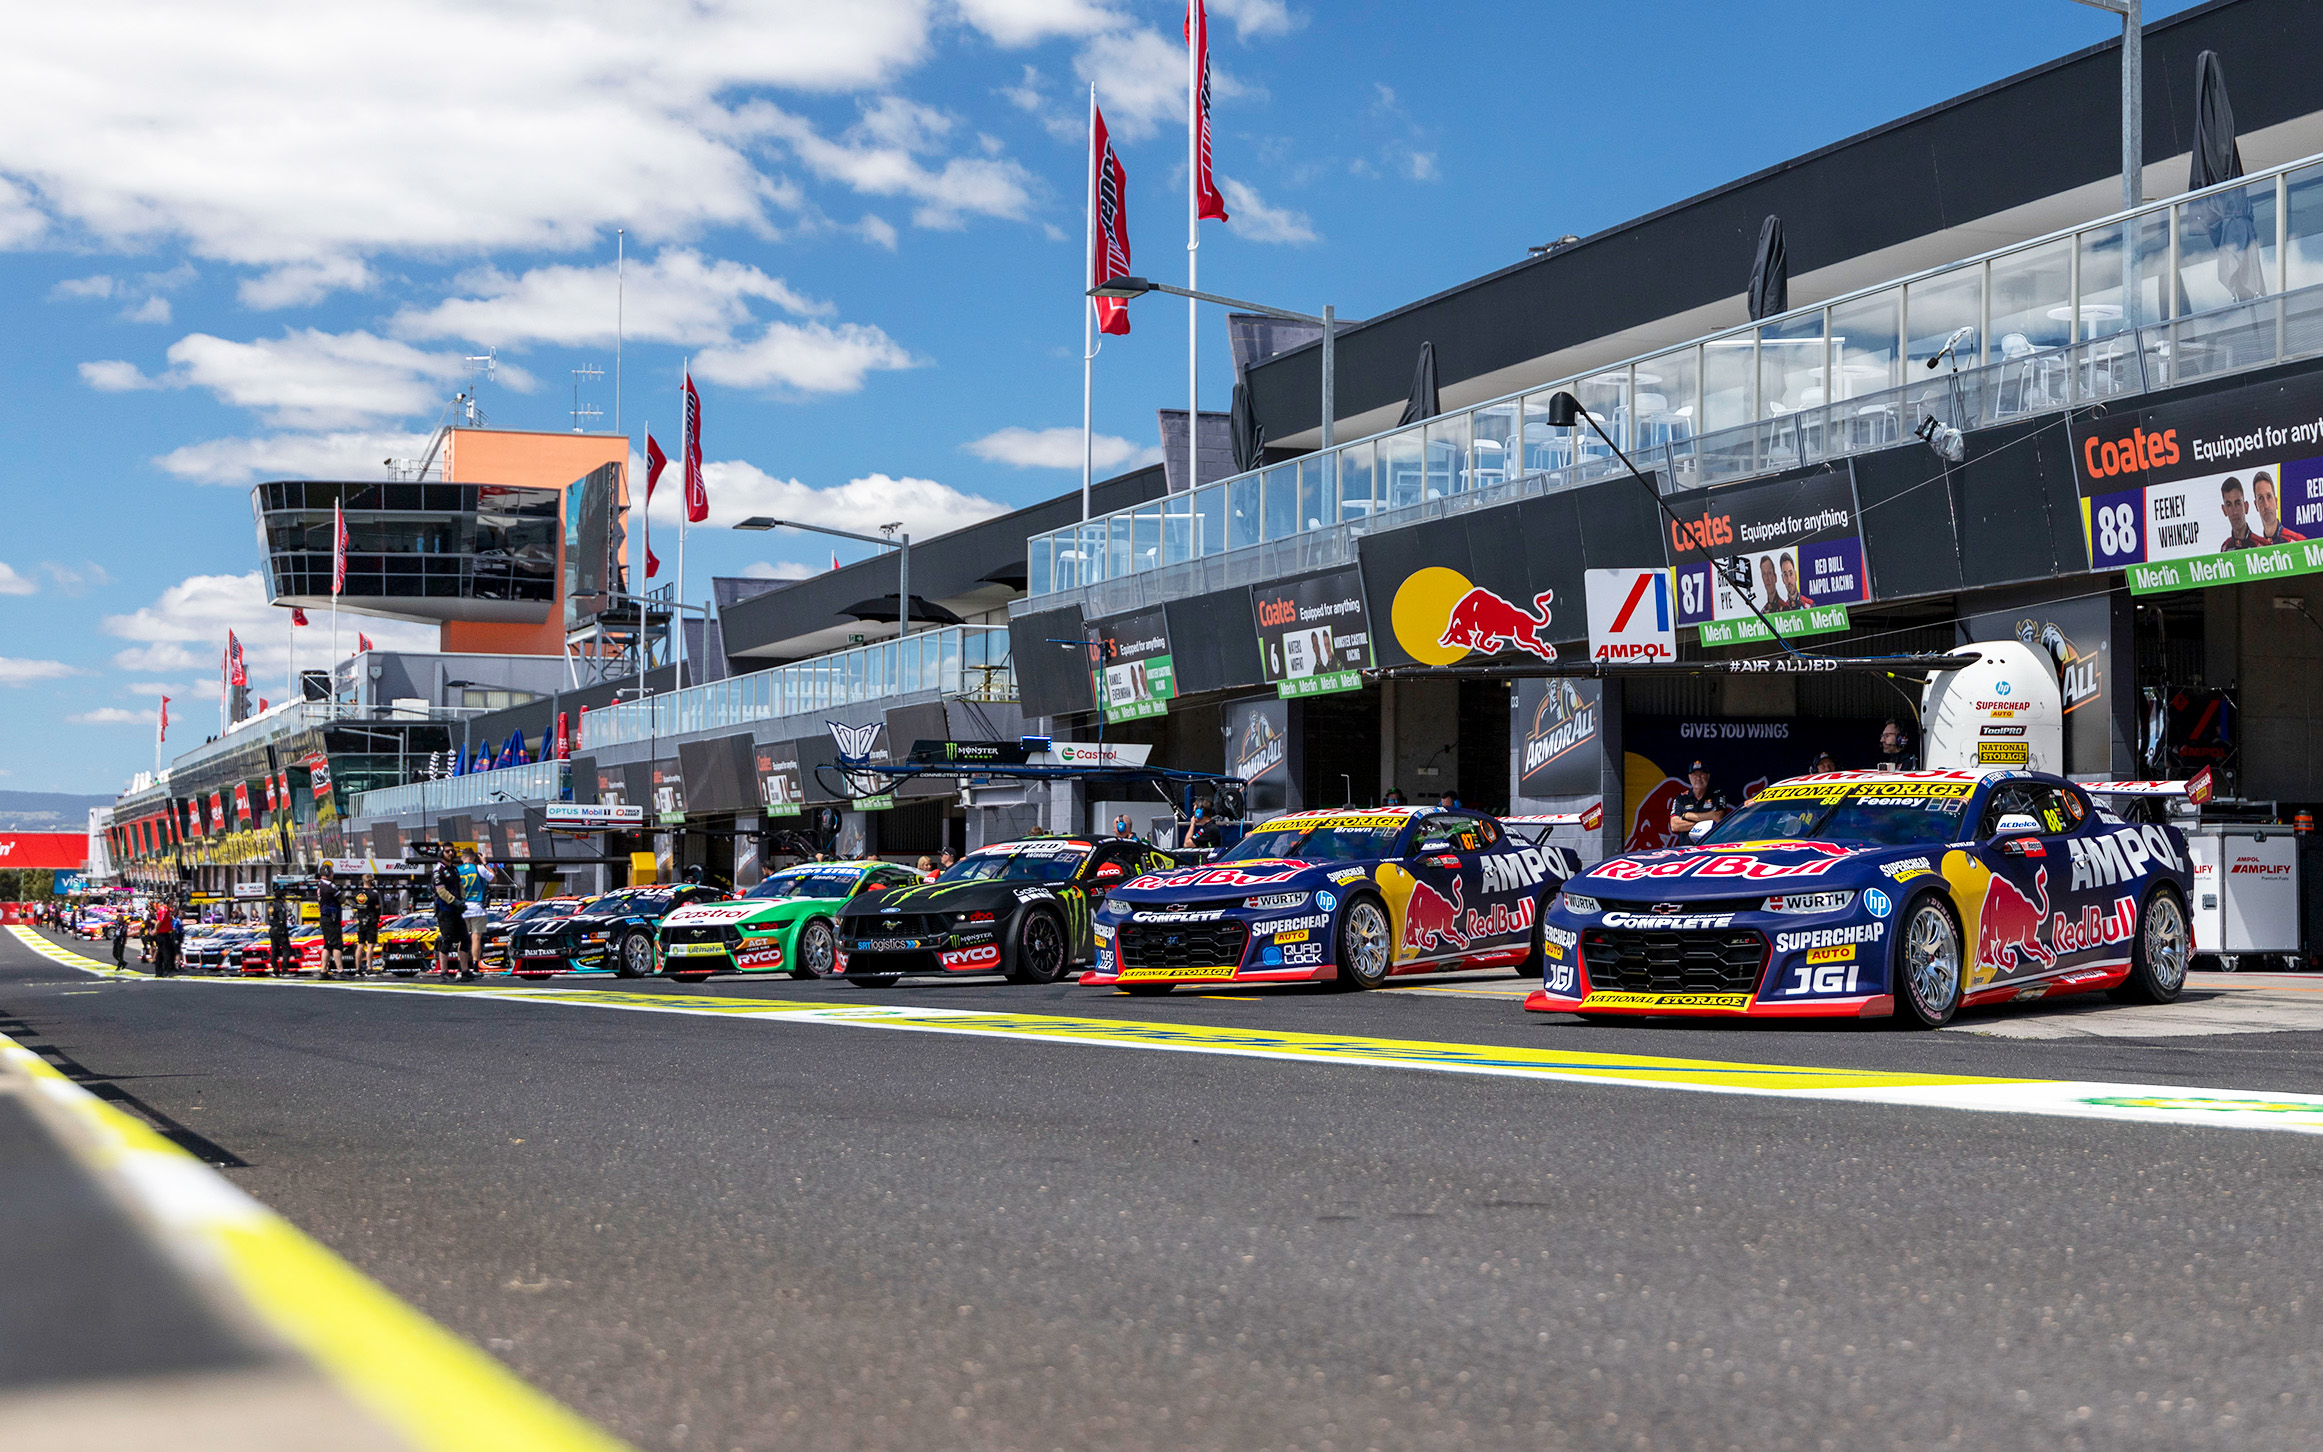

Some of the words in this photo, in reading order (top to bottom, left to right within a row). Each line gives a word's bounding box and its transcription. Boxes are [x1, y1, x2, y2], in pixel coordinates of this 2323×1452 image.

[2084, 427, 2180, 478] Coates
[2193, 428, 2264, 462] Equipped
[2265, 426, 2287, 446] for
[2154, 494, 2186, 521] FEENEY
[1671, 512, 1733, 552] Coates
[1740, 516, 1787, 542] Equipped
[1787, 515, 1802, 533] for
[1804, 508, 1848, 532] anything
[2098, 502, 2137, 556] 88
[2158, 521, 2199, 548] WHINCUP
[1814, 559, 1826, 574] RED
[1828, 556, 1844, 571] BULL
[2189, 558, 2235, 582] Merlin
[2245, 550, 2293, 575] Merlin
[1808, 576, 1830, 596] AMPOL
[1831, 573, 1854, 592] RACING
[2135, 565, 2180, 589] Merlin
[1680, 572, 1705, 614] 87
[1720, 591, 1733, 610] PYE
[1259, 597, 1295, 627] Coates
[1300, 604, 1324, 622] Equipped
[1324, 603, 1332, 616] for
[1334, 598, 1360, 615] anything
[1737, 619, 1768, 638] Merlin
[1775, 614, 1803, 633] Merlin
[1811, 610, 1845, 630] Merlin
[1705, 624, 1732, 642] Merlin
[1287, 640, 1302, 654] WATERS
[1595, 643, 1671, 659] AMPOL
[1271, 643, 1279, 674] 6
[1730, 659, 1770, 673] #AIR
[1774, 659, 1838, 672] ALLIED
[1299, 679, 1318, 693] Merlin
[1321, 676, 1338, 690] Merlin
[1341, 673, 1360, 687] Merlin
[1997, 681, 2010, 695] hp
[1976, 701, 2030, 711] SUPERCHEAP
[1681, 723, 1717, 738] GIVES
[1719, 723, 1745, 738] YOU
[1747, 723, 1789, 738] WINGS
[1983, 727, 2023, 735] ToolPRO
[1077, 749, 1117, 760] Castrol
[1755, 786, 1847, 800] NATIONAL
[1856, 785, 1964, 795] STORAGE
[1820, 797, 1842, 805] 88
[1857, 797, 1925, 807] Feeney
[1326, 817, 1401, 826] STORAGE
[2043, 808, 2062, 832] 88
[1460, 833, 1475, 850] 87
[1879, 857, 1930, 877] SUPERCHEAP
[2067, 824, 2185, 892] AMPOL
[1097, 868, 1120, 877] RYCO
[1327, 866, 1366, 883] SUPERCHEAP
[1480, 847, 1575, 894] AMPOL
[1586, 856, 1711, 881] Red
[1693, 855, 1852, 880] Bull
[2194, 865, 2212, 873] LIFY
[2240, 865, 2291, 873] AMPLIFY
[1123, 870, 1202, 890] Red
[1195, 869, 1304, 886] Bull
[604, 889, 676, 898] OPTUS
[1013, 887, 1050, 897] GoPro
[1261, 893, 1303, 905] WÜRTH
[1318, 891, 1335, 911] hp
[1787, 893, 1846, 908] WÜRTH
[1866, 889, 1890, 918] hp
[671, 909, 751, 920] Castrol
[759, 922, 778, 930] dba
[970, 911, 994, 920] dba
[1133, 912, 1223, 922] COMPLETE
[1252, 913, 1330, 937] SUPERCHEAP
[1466, 904, 1496, 939] Red
[1496, 896, 1535, 935] Bull
[1602, 912, 1732, 929] COMPLETE
[2052, 905, 2088, 955] Red
[2088, 895, 2136, 947] Bull
[748, 938, 768, 947] ACT
[1278, 931, 1306, 941] AUTO
[1776, 922, 1884, 952] SUPERCHEAP
[688, 946, 721, 954] ultimate
[737, 950, 781, 965] RYCO
[942, 946, 997, 965] RYCO
[1284, 943, 1322, 955] QUAD
[1812, 948, 1850, 960] AUTO
[1284, 953, 1322, 965] LOCK
[1174, 968, 1232, 977] STORAGE
[1546, 964, 1574, 991] JGI
[1786, 966, 1859, 995] JGI
[1587, 994, 1654, 1004] NATIONAL
[1661, 995, 1742, 1006] STORAGE
